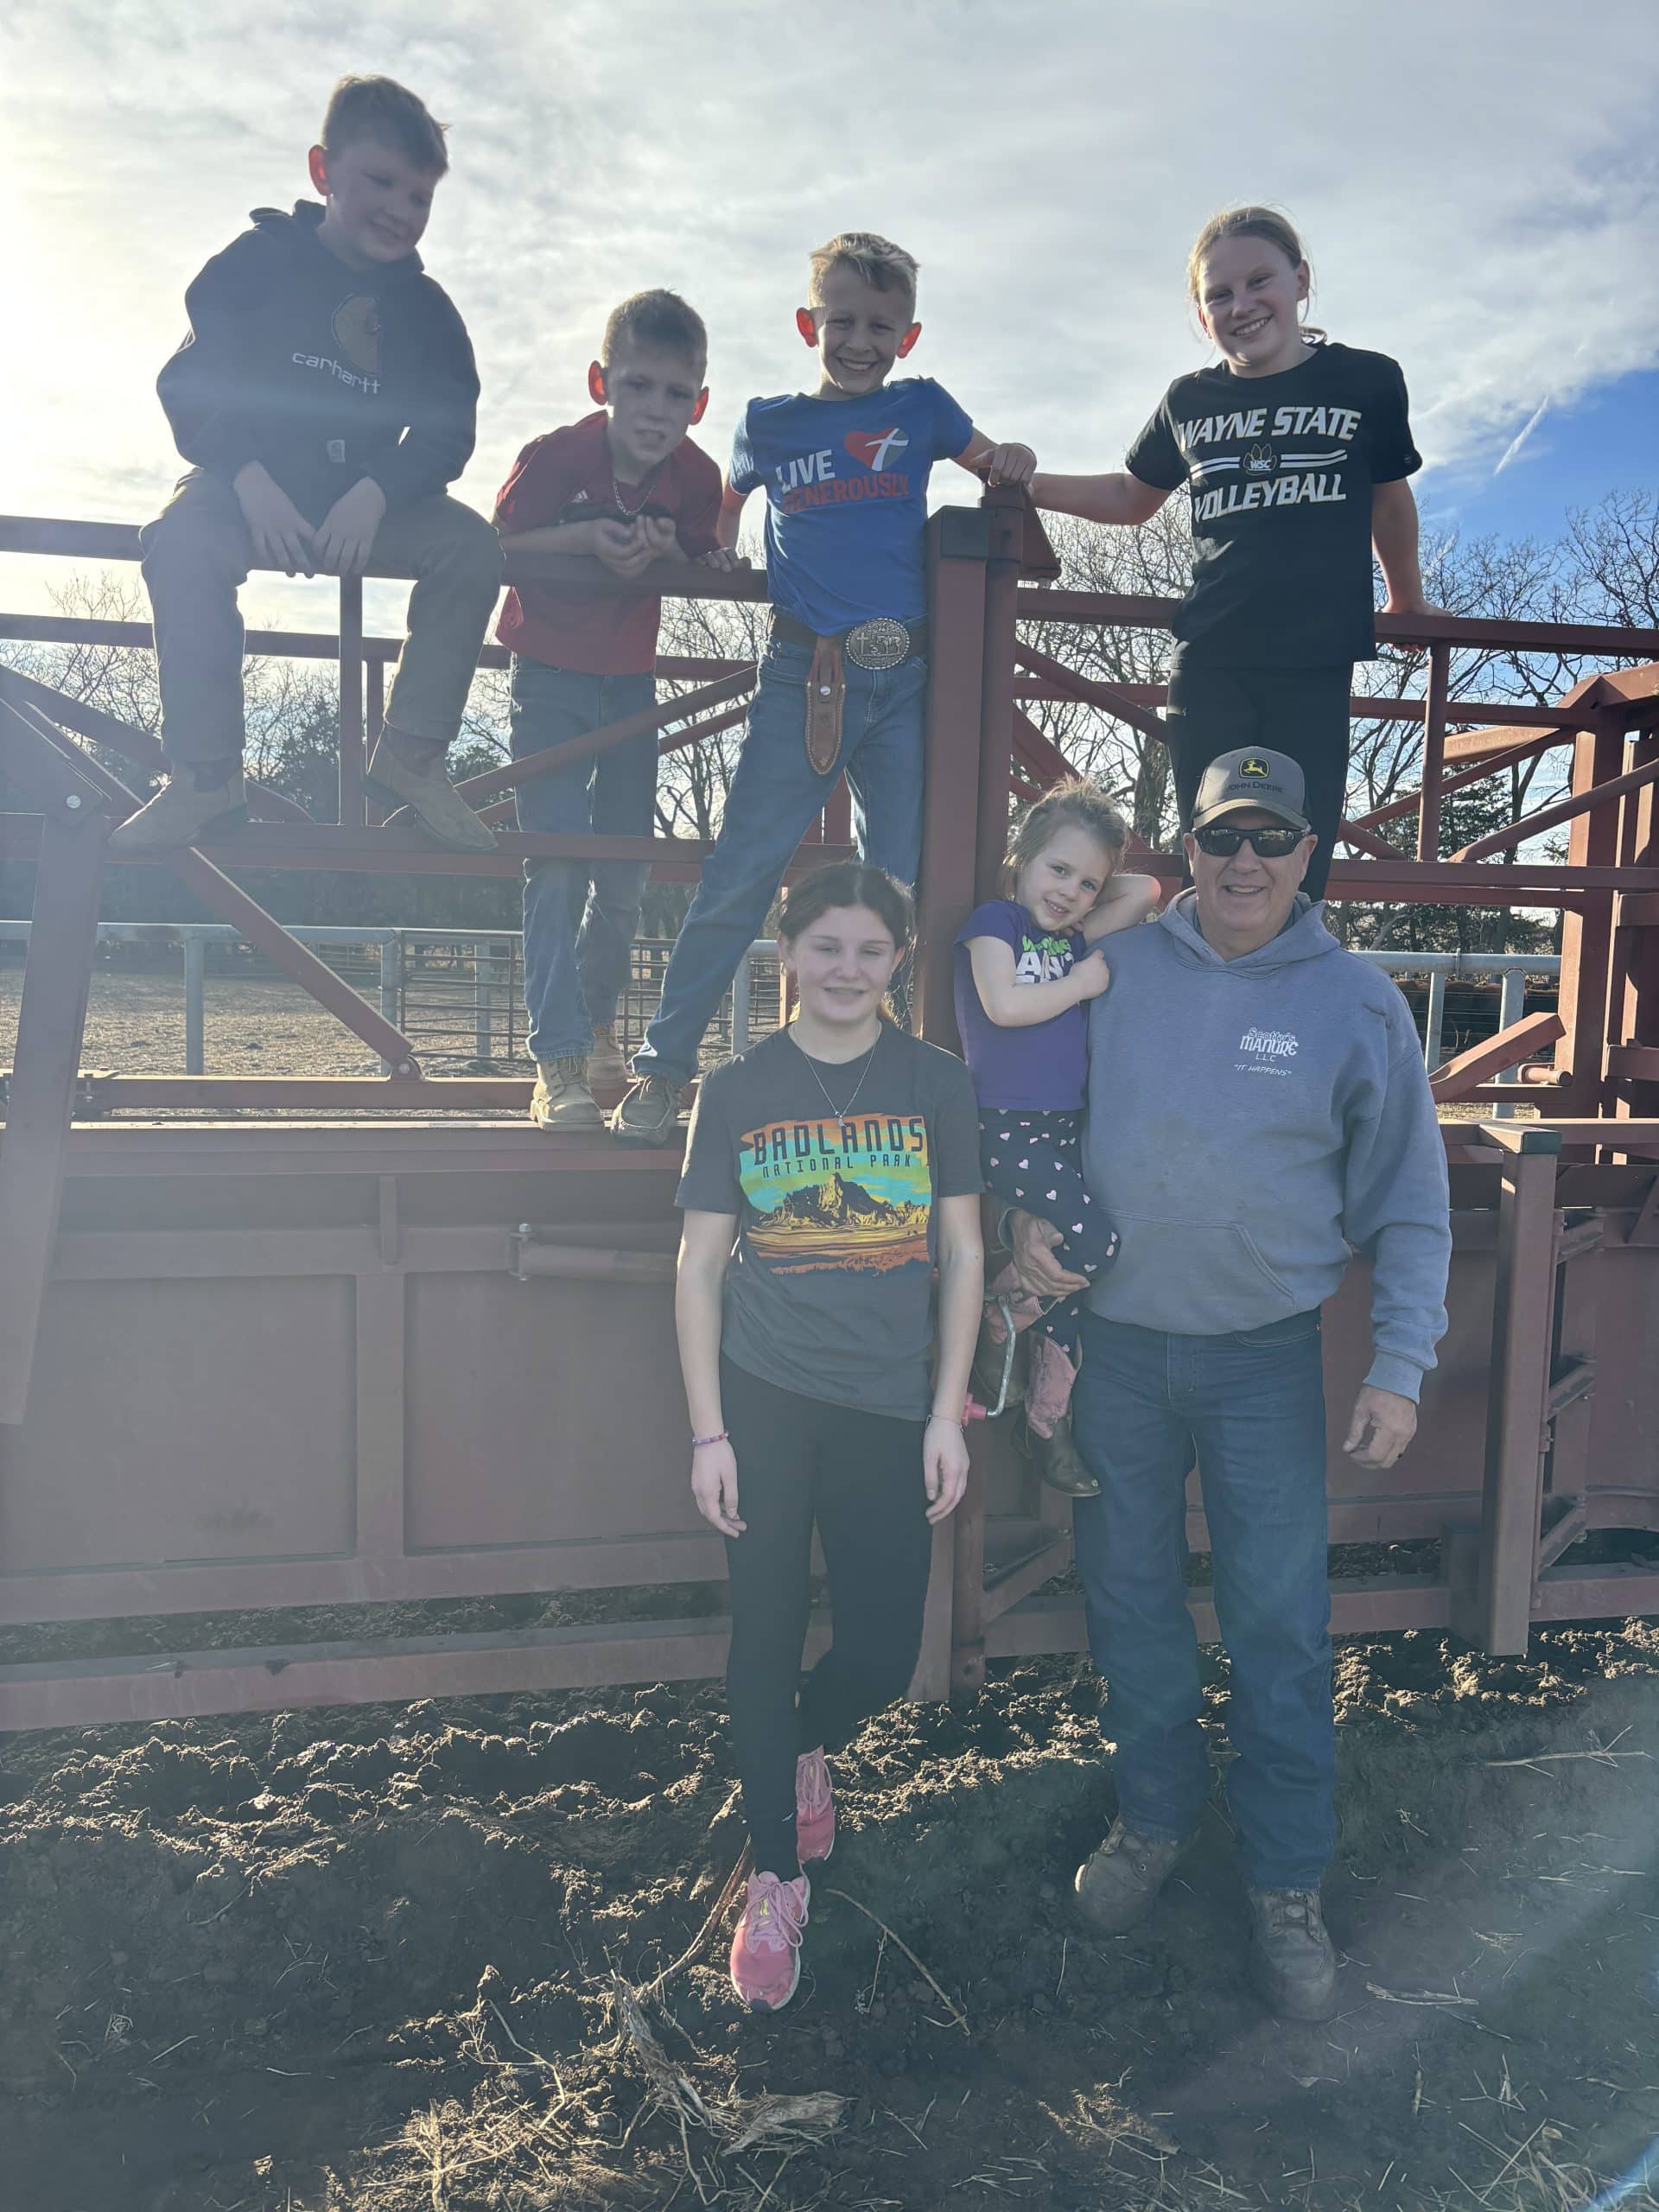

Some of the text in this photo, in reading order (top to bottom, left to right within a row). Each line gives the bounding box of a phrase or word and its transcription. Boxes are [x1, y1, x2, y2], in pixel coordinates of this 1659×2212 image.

[292, 353, 380, 394] carhartt
[1178, 407, 1362, 452] WAYNE STATE
[776, 449, 836, 493] LIVE
[1194, 474, 1346, 523] VOLLEYBALL
[1239, 1035, 1299, 1057] MANURE
[753, 1118, 924, 1165] BADLANDS
[763, 1154, 911, 1178] NATIONAL PARK
